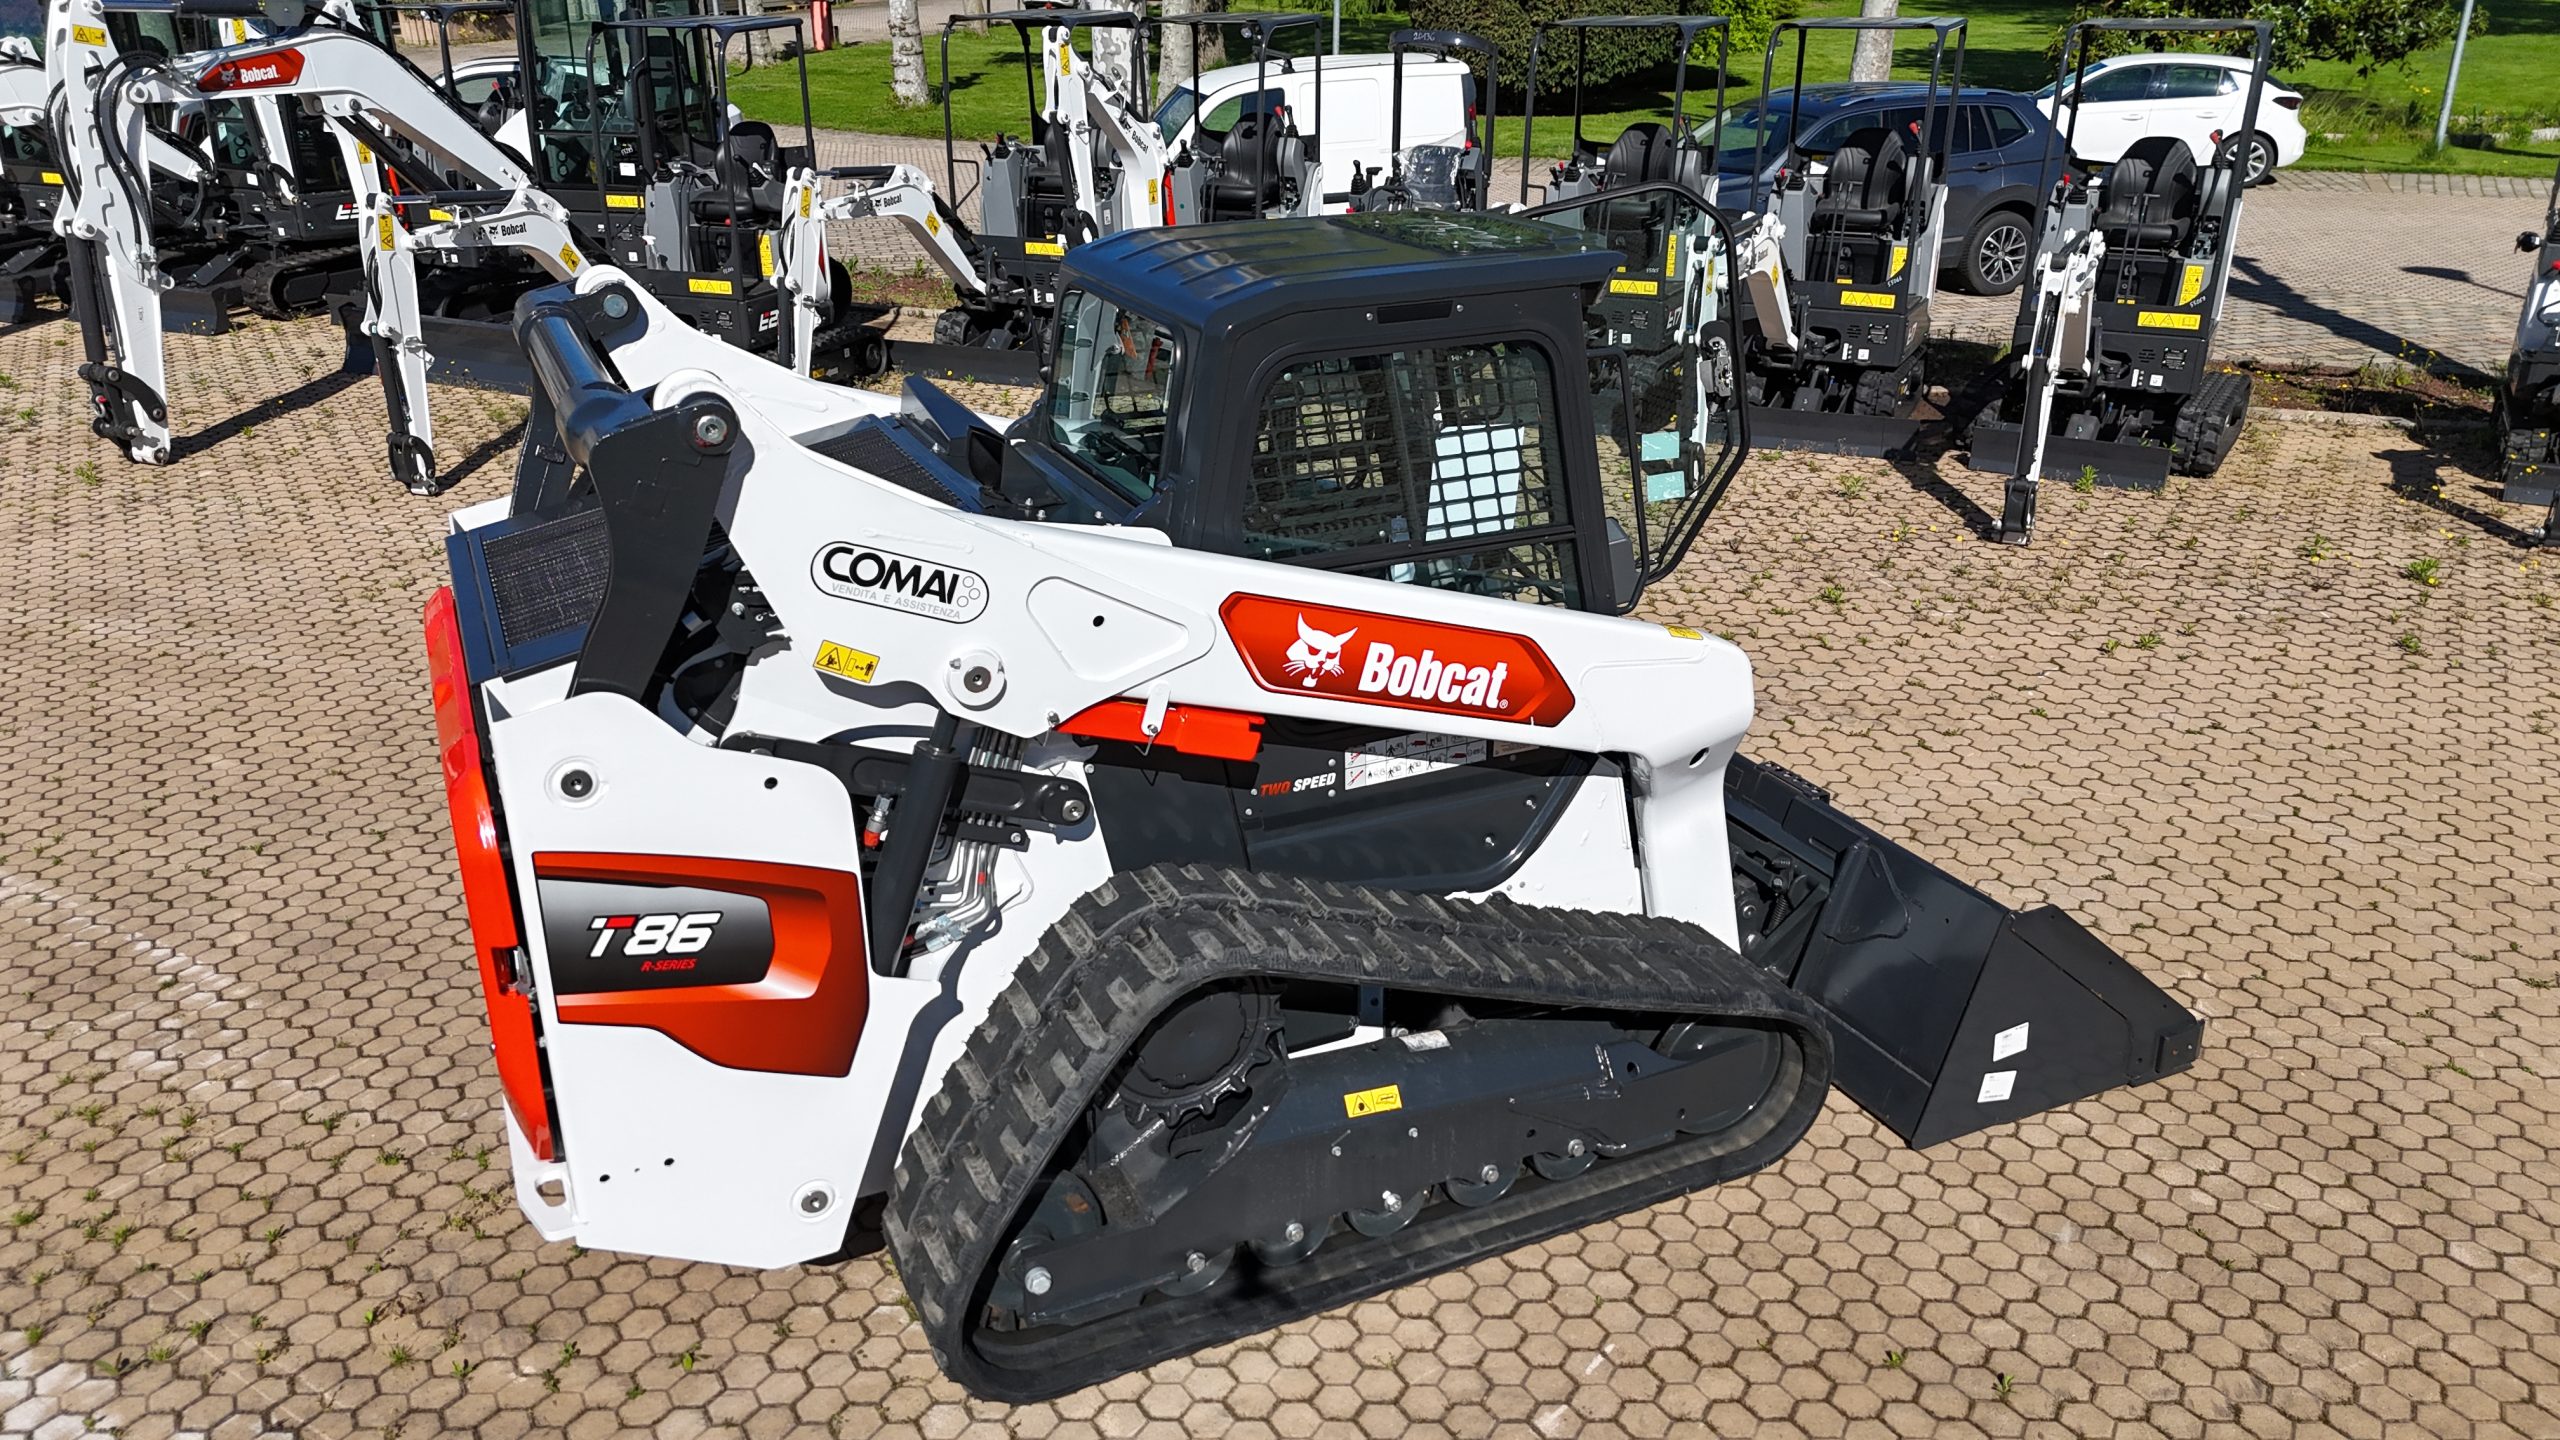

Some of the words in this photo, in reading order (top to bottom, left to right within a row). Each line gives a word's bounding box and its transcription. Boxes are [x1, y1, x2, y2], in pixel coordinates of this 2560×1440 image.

[240, 64, 278, 84] Bobcat
[883, 193, 902, 208] Bobcat
[501, 221, 527, 236] Bobcat
[823, 546, 960, 605] COMAI
[832, 582, 877, 601] VENDITA
[883, 594, 891, 603] E
[894, 596, 961, 620] ASSISTENZA
[1358, 641, 1509, 709] Bobcat
[1260, 780, 1291, 797] TWO
[1292, 772, 1337, 792] SPEED
[589, 911, 723, 958] T86
[641, 958, 697, 972] R-SERIES
